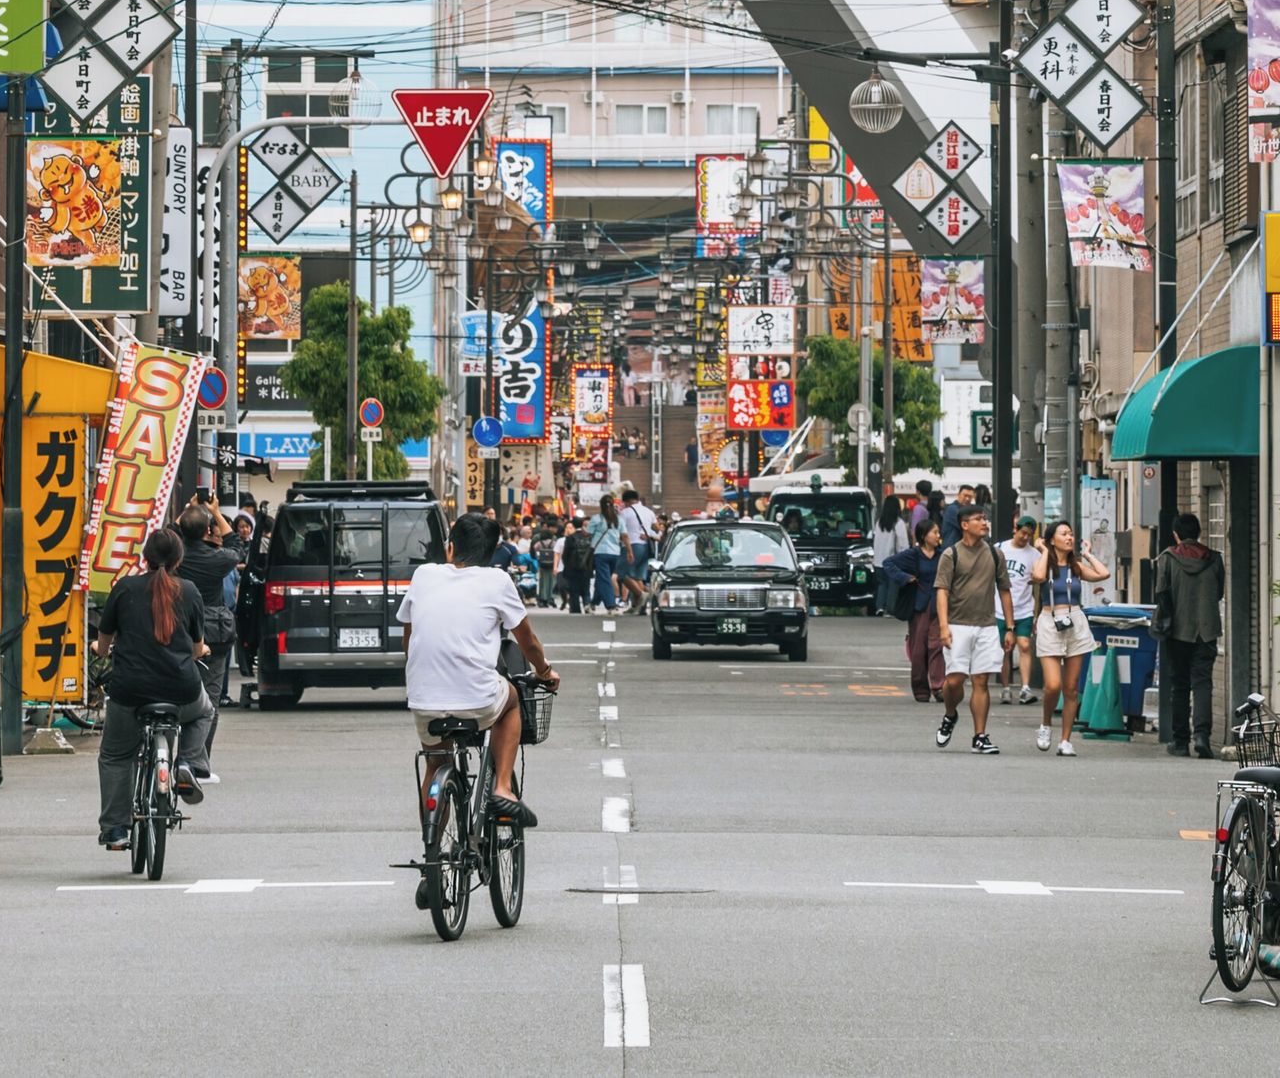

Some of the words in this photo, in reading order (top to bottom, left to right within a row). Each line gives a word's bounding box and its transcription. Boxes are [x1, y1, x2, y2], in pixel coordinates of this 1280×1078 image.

[75, 45, 92, 110] 春日町会
[1040, 36, 1064, 82] 更科
[414, 106, 473, 127] 止まれ
[1097, 80, 1112, 132] 春日町会
[261, 141, 300, 155] だるま
[946, 131, 959, 170] 近江屋
[172, 144, 186, 215] SUNTORY
[291, 174, 334, 187] BABY
[272, 191, 283, 233] 春日町会
[947, 197, 960, 236] 近江屋
[172, 270, 185, 302] BAR
[108, 396, 127, 434] SALE!
[97, 448, 114, 485] SALE!
[88, 499, 104, 535] SALE!
[34, 429, 79, 682] ガクブチ
[79, 549, 92, 586] SALE!
